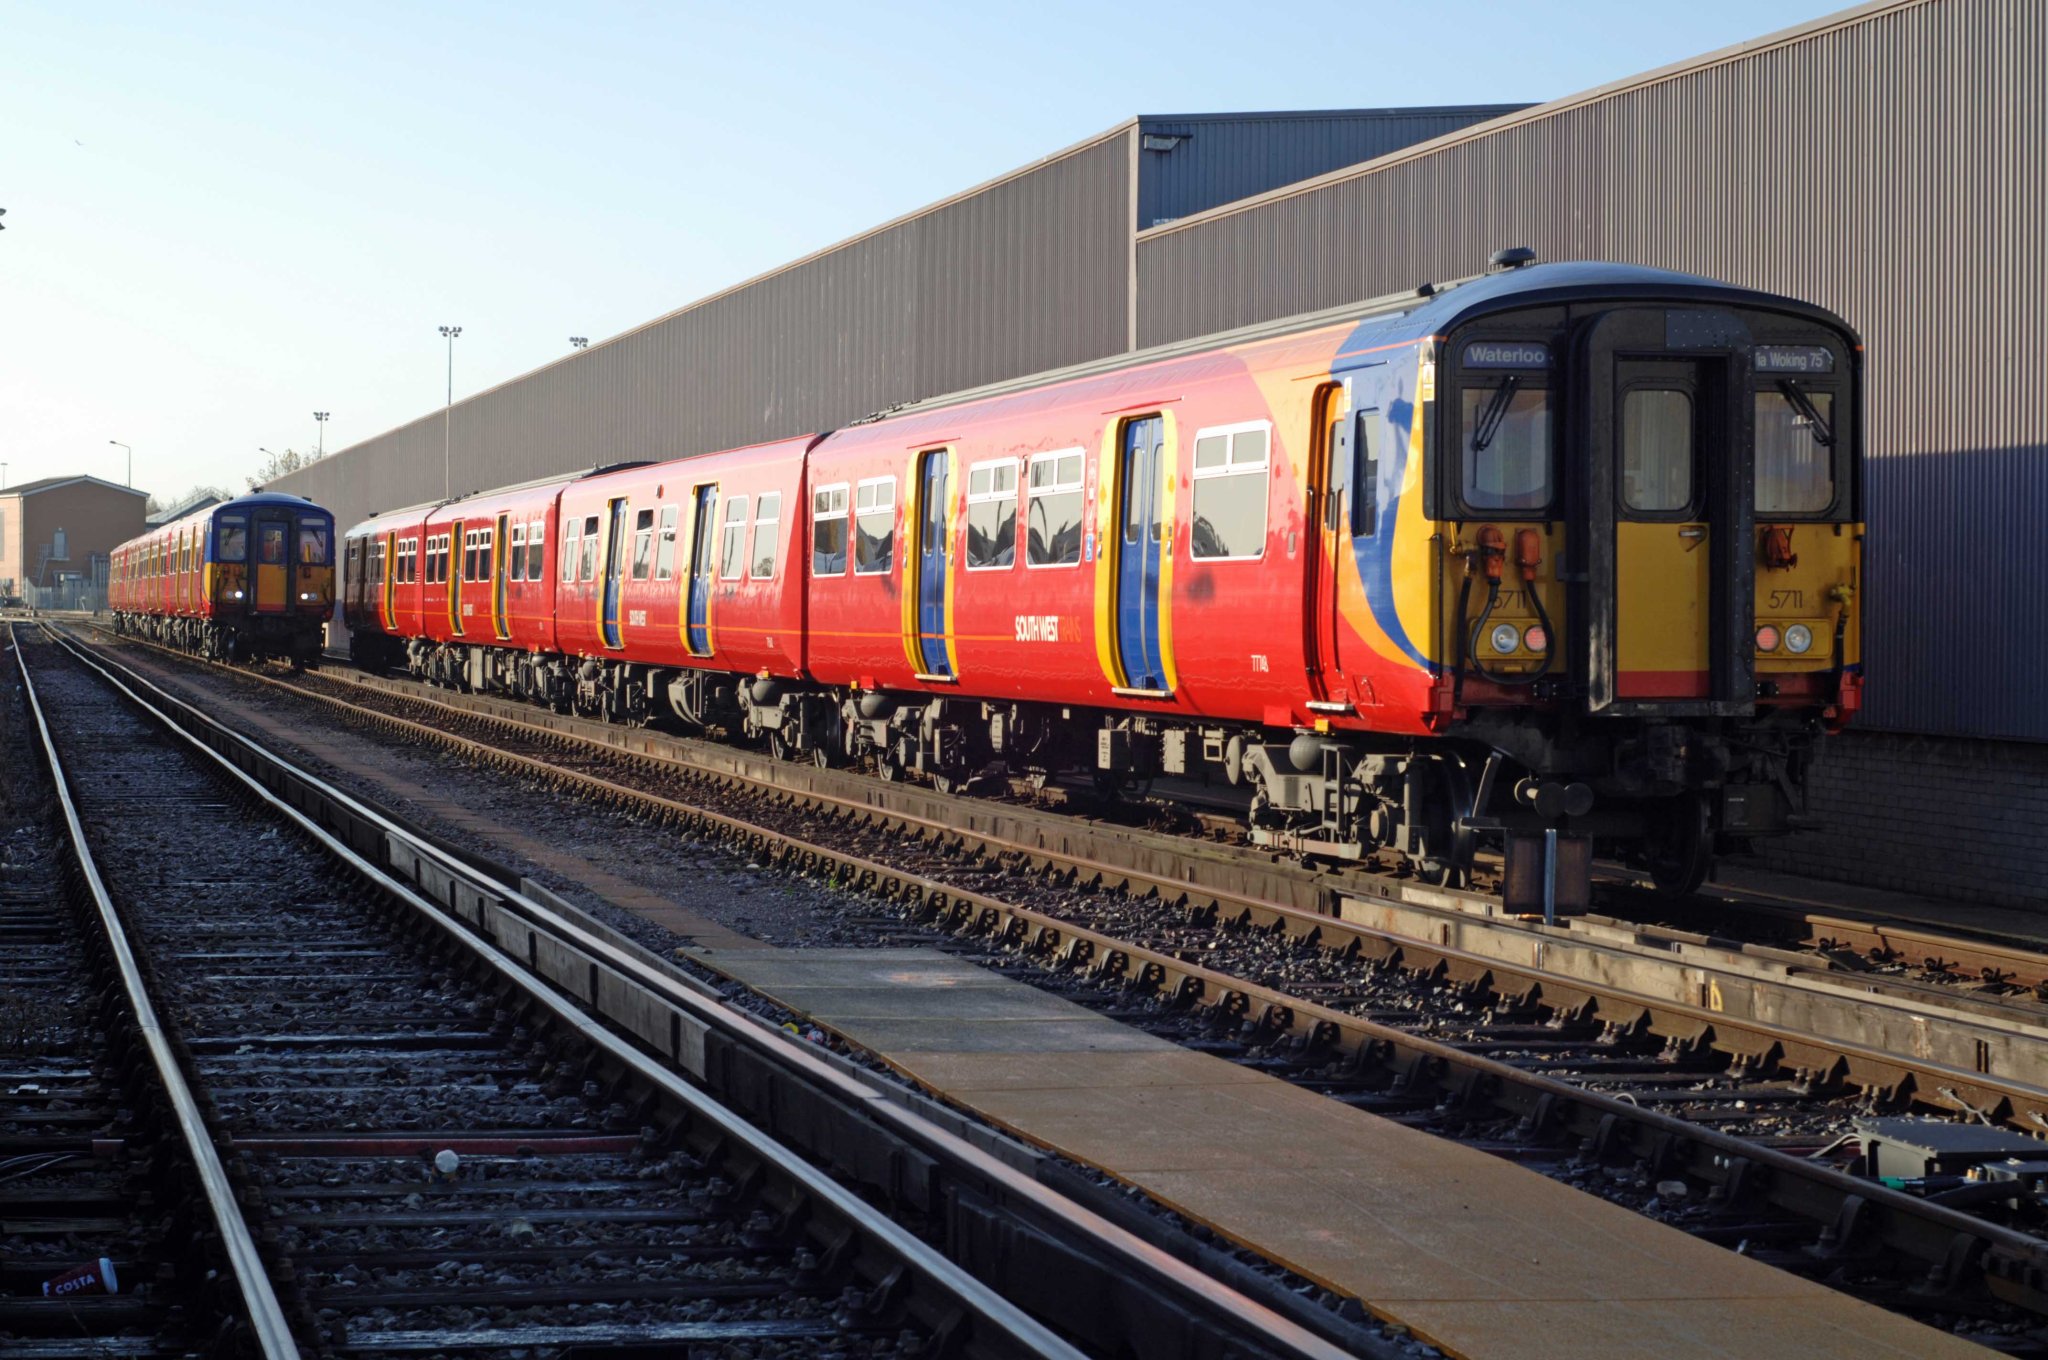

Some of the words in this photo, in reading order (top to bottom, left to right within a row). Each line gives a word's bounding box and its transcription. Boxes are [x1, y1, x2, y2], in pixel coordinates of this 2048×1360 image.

[1470, 346, 1545, 363] Waterloo
[1769, 351, 1807, 371] Woking
[1809, 352, 1824, 368] 75
[1768, 589, 1803, 609] 5711
[55, 1273, 96, 1295] COSTA
